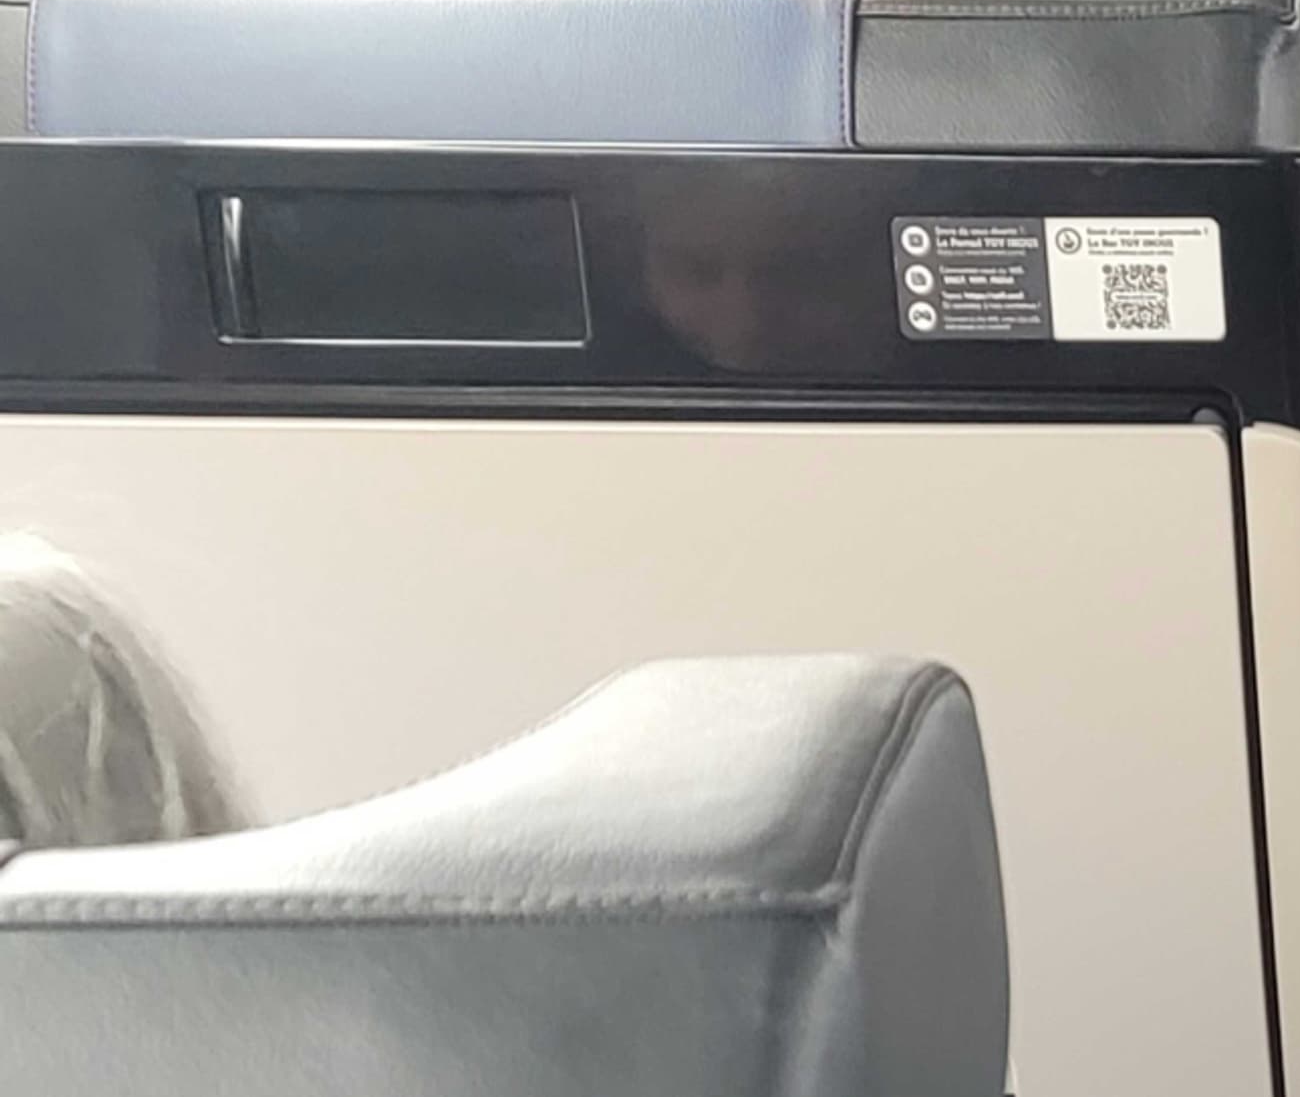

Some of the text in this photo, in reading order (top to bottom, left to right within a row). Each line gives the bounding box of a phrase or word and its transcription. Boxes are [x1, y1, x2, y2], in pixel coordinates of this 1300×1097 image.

[983, 237, 1005, 248] TGV
[1087, 238, 1099, 248] Le
[1119, 238, 1140, 248] TGV
